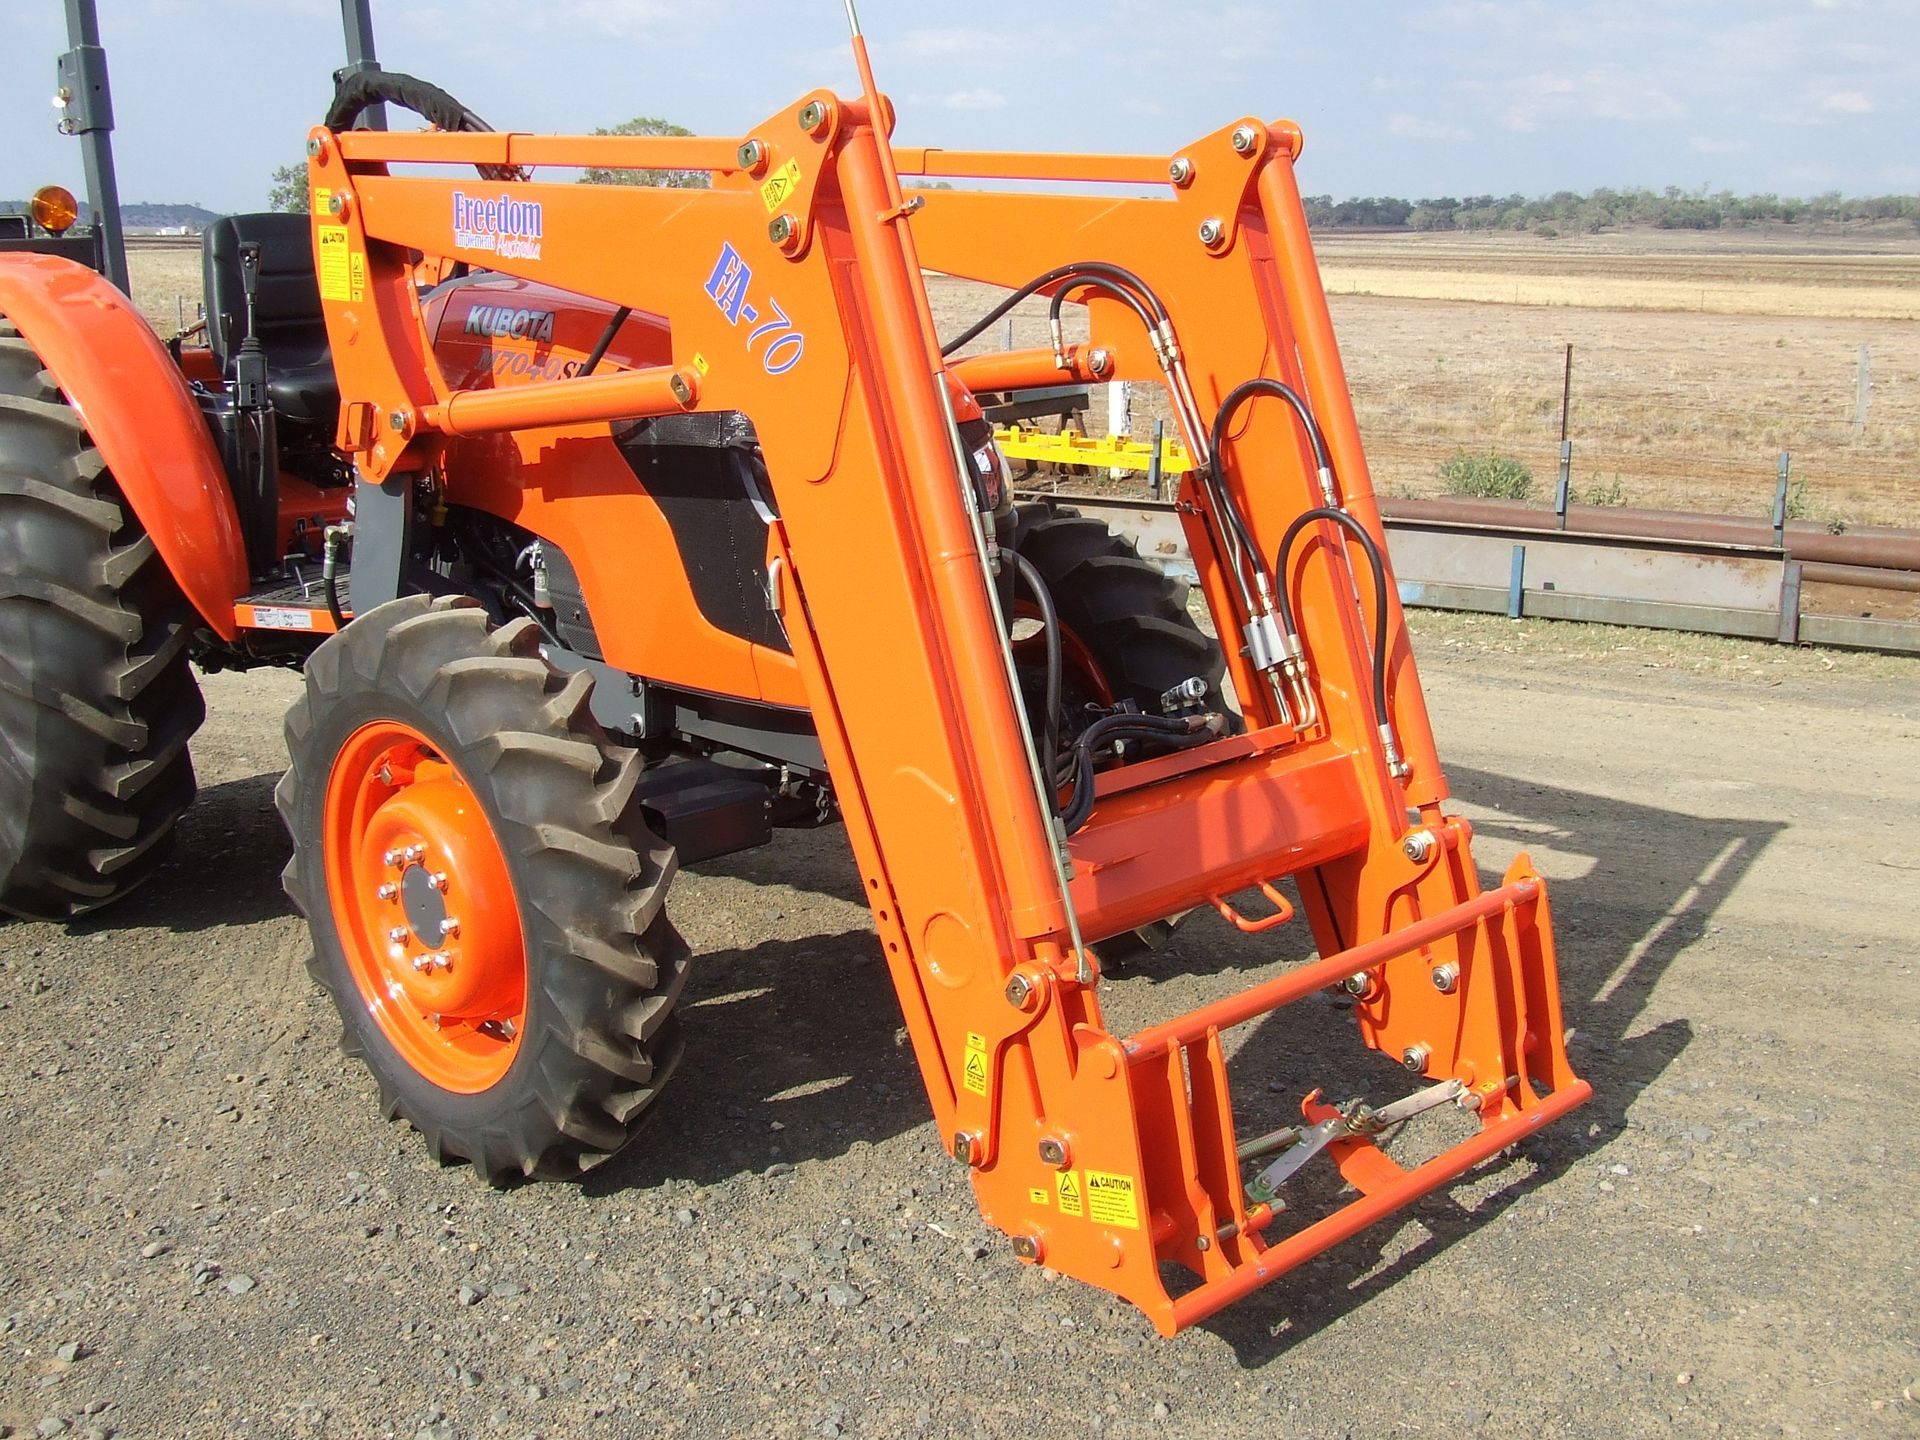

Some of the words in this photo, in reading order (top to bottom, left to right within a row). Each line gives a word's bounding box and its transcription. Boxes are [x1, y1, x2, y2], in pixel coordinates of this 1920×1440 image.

[454, 192, 542, 237] Freedom
[464, 304, 556, 343] KUBOTA
[703, 240, 804, 375] FA-70
[1100, 1176, 1132, 1192] CAUTION
